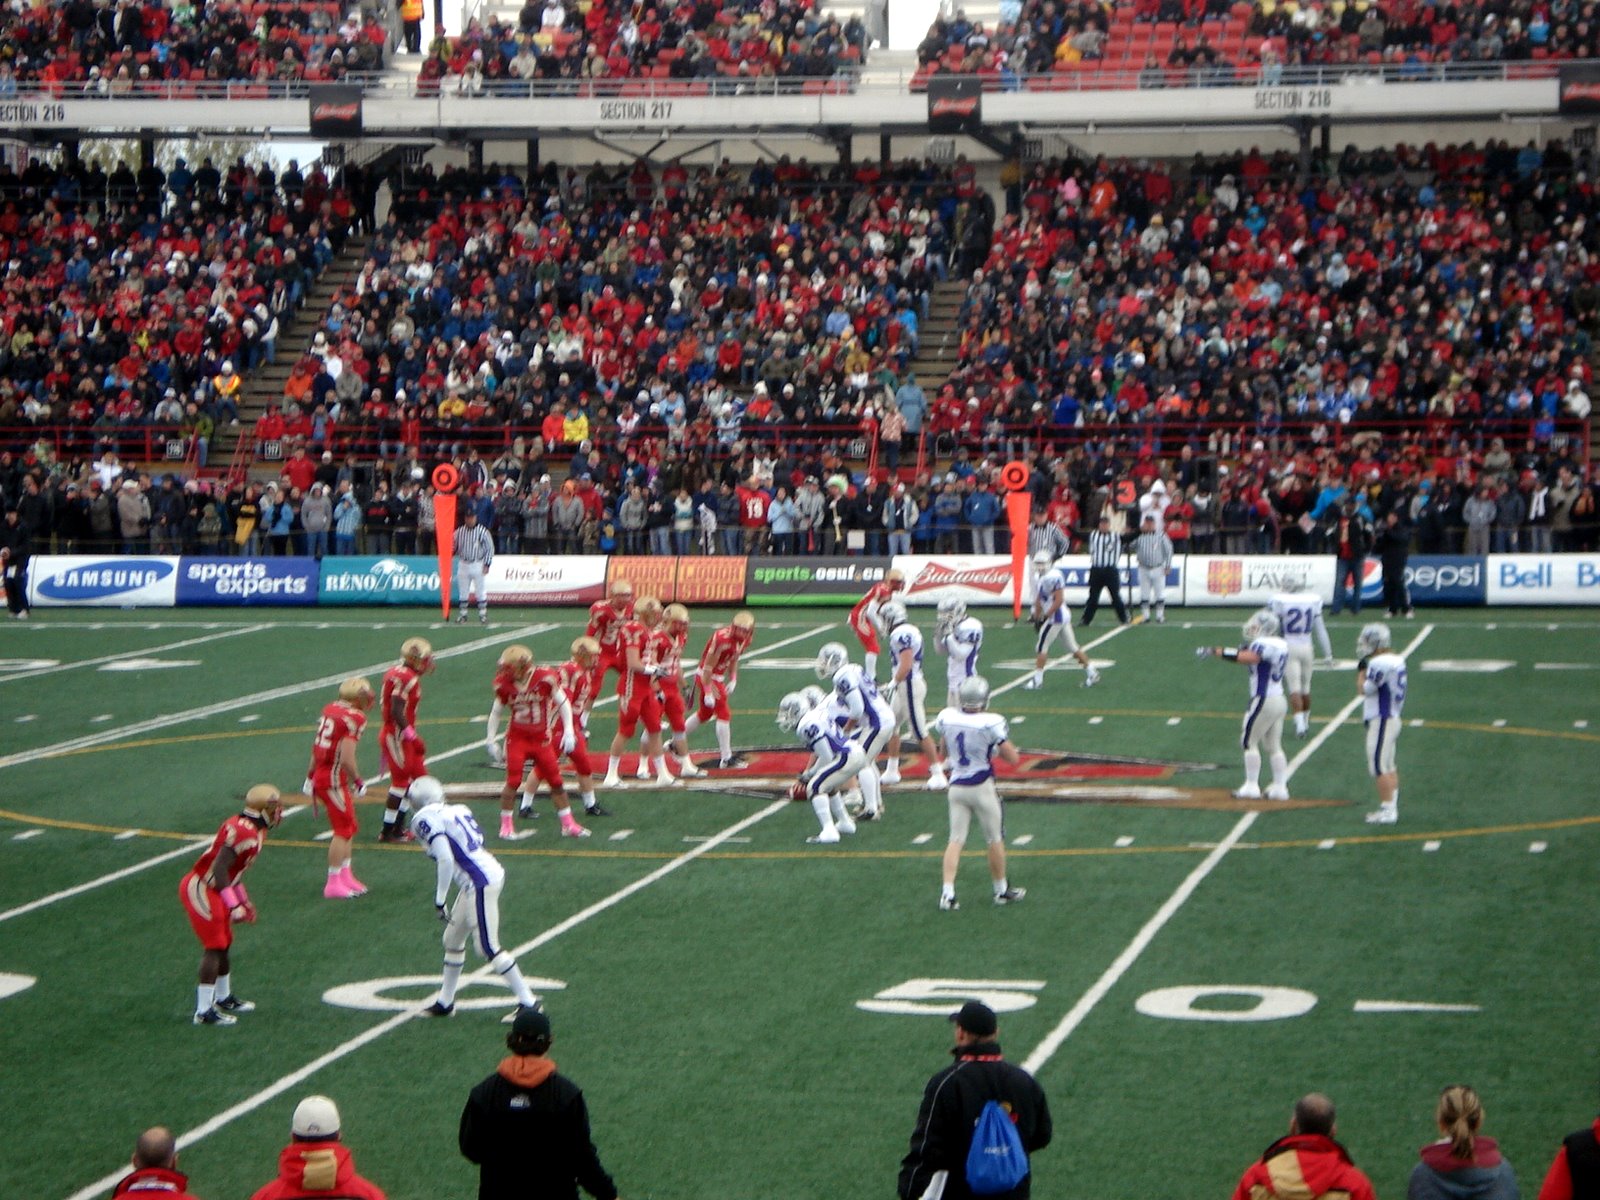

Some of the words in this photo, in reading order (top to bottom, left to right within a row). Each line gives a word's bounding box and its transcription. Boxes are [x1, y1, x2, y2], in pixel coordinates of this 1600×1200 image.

[1255, 89, 1303, 109] SECTION
[42, 104, 65, 121] 216
[600, 101, 646, 120] SECTION
[651, 101, 673, 119] 217
[53, 568, 158, 588] SAMSUNG
[187, 561, 266, 583] sports
[391, 570, 452, 592] DÉPÔ
[539, 567, 564, 581] Sud
[913, 565, 1014, 585] Budweise
[1500, 561, 1553, 588] Bell
[215, 574, 308, 598] experts
[1286, 608, 1313, 634] 21
[513, 702, 541, 725] 21
[955, 731, 971, 767] 1
